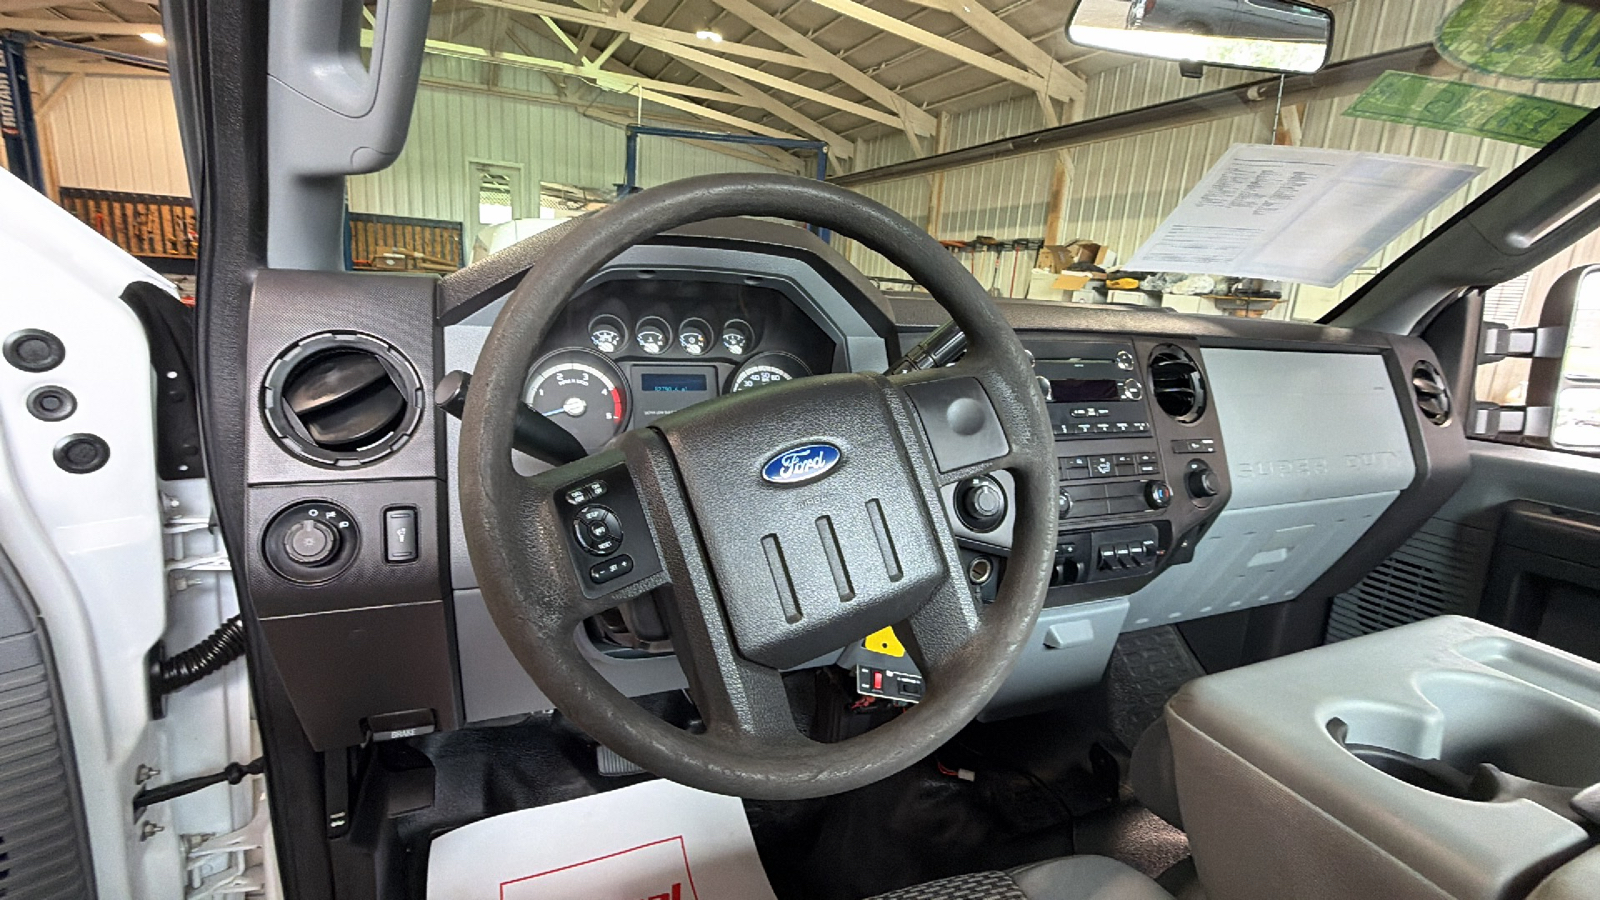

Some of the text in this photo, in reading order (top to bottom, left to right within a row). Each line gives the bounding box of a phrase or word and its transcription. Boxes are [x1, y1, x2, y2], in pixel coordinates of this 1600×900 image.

[556, 373, 564, 381] 2
[582, 373, 589, 381] 3
[743, 380, 754, 388] 30
[601, 388, 608, 396] 4
[779, 449, 826, 479] Ford
[391, 728, 416, 739] BRAKE
